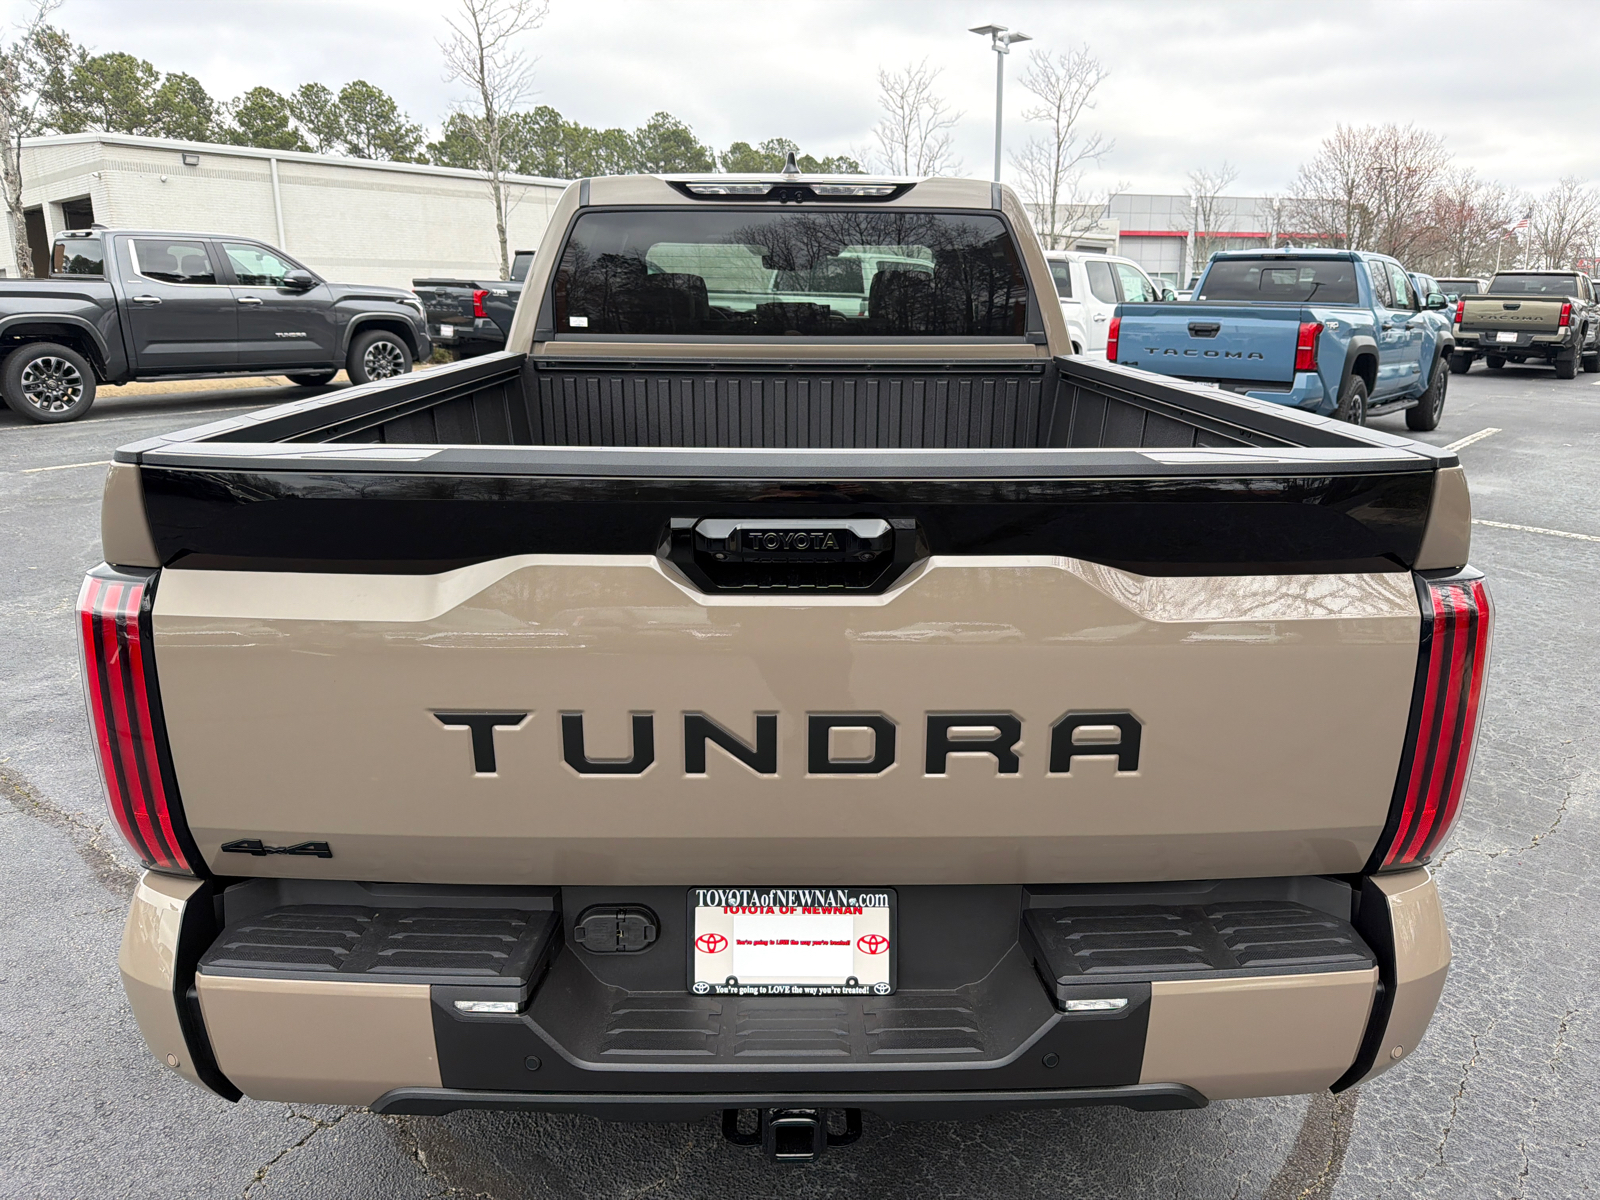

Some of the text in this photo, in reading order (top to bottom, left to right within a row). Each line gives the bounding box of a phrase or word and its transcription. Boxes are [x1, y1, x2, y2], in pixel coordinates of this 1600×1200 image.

[1145, 347, 1264, 361] TACOMA
[749, 532, 839, 550] TOYOTA
[428, 709, 1144, 778] TUNDRA
[722, 906, 863, 915] TOYOTA OF NEWNAN
[753, 939, 769, 947] going
[715, 985, 870, 996] You're going to LOVE the way you're treated!
